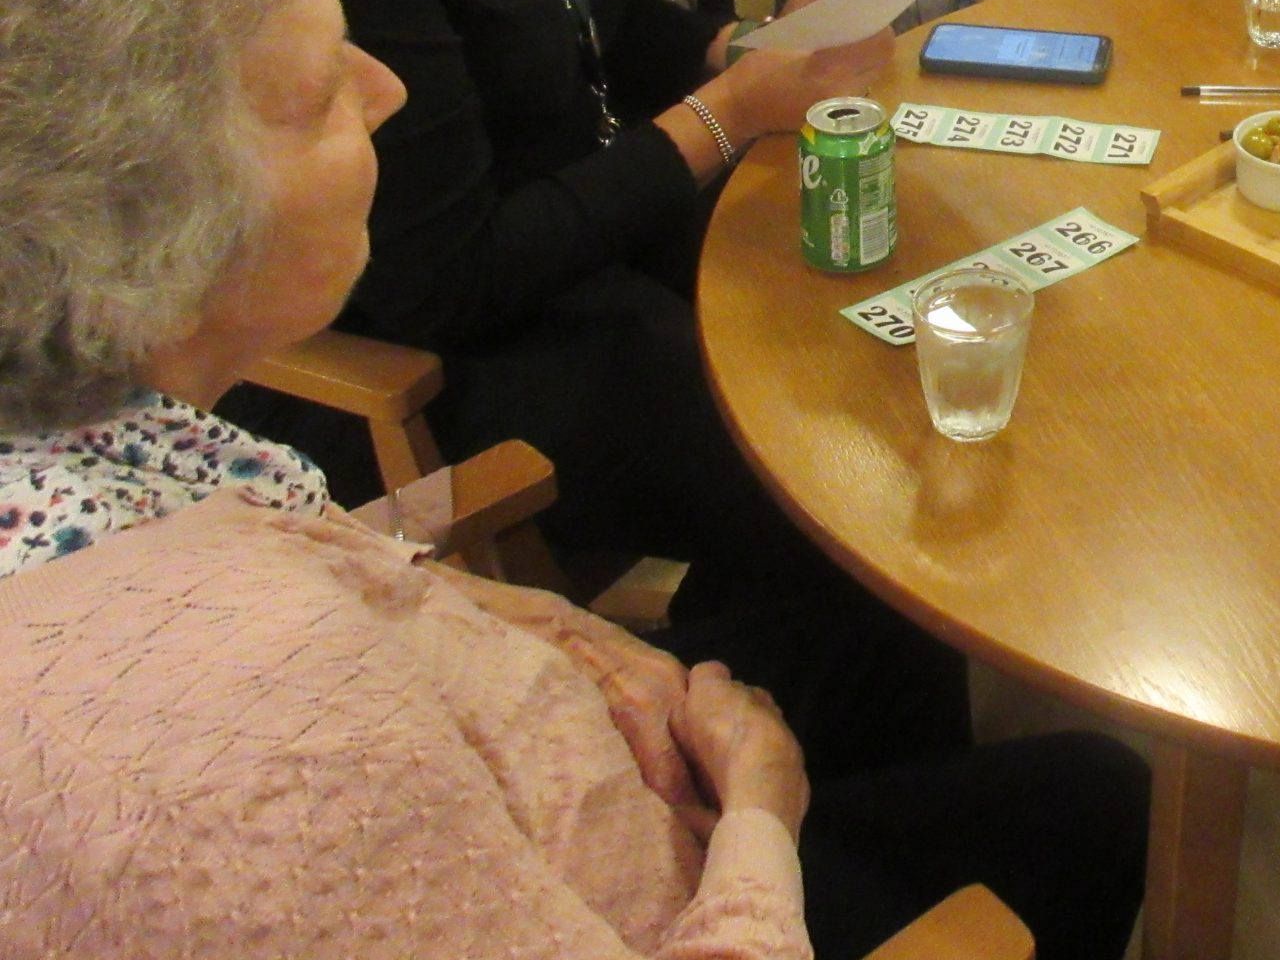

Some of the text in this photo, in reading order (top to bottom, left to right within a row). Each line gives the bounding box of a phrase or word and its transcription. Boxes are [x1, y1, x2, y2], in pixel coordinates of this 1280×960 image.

[895, 109, 928, 137] 275
[947, 115, 980, 142] 274
[1000, 120, 1032, 147] 273
[1054, 124, 1085, 154] 272
[1107, 132, 1137, 158] 271
[1055, 222, 1113, 254] 266
[1009, 242, 1069, 273] 267
[857, 305, 915, 338] 270
